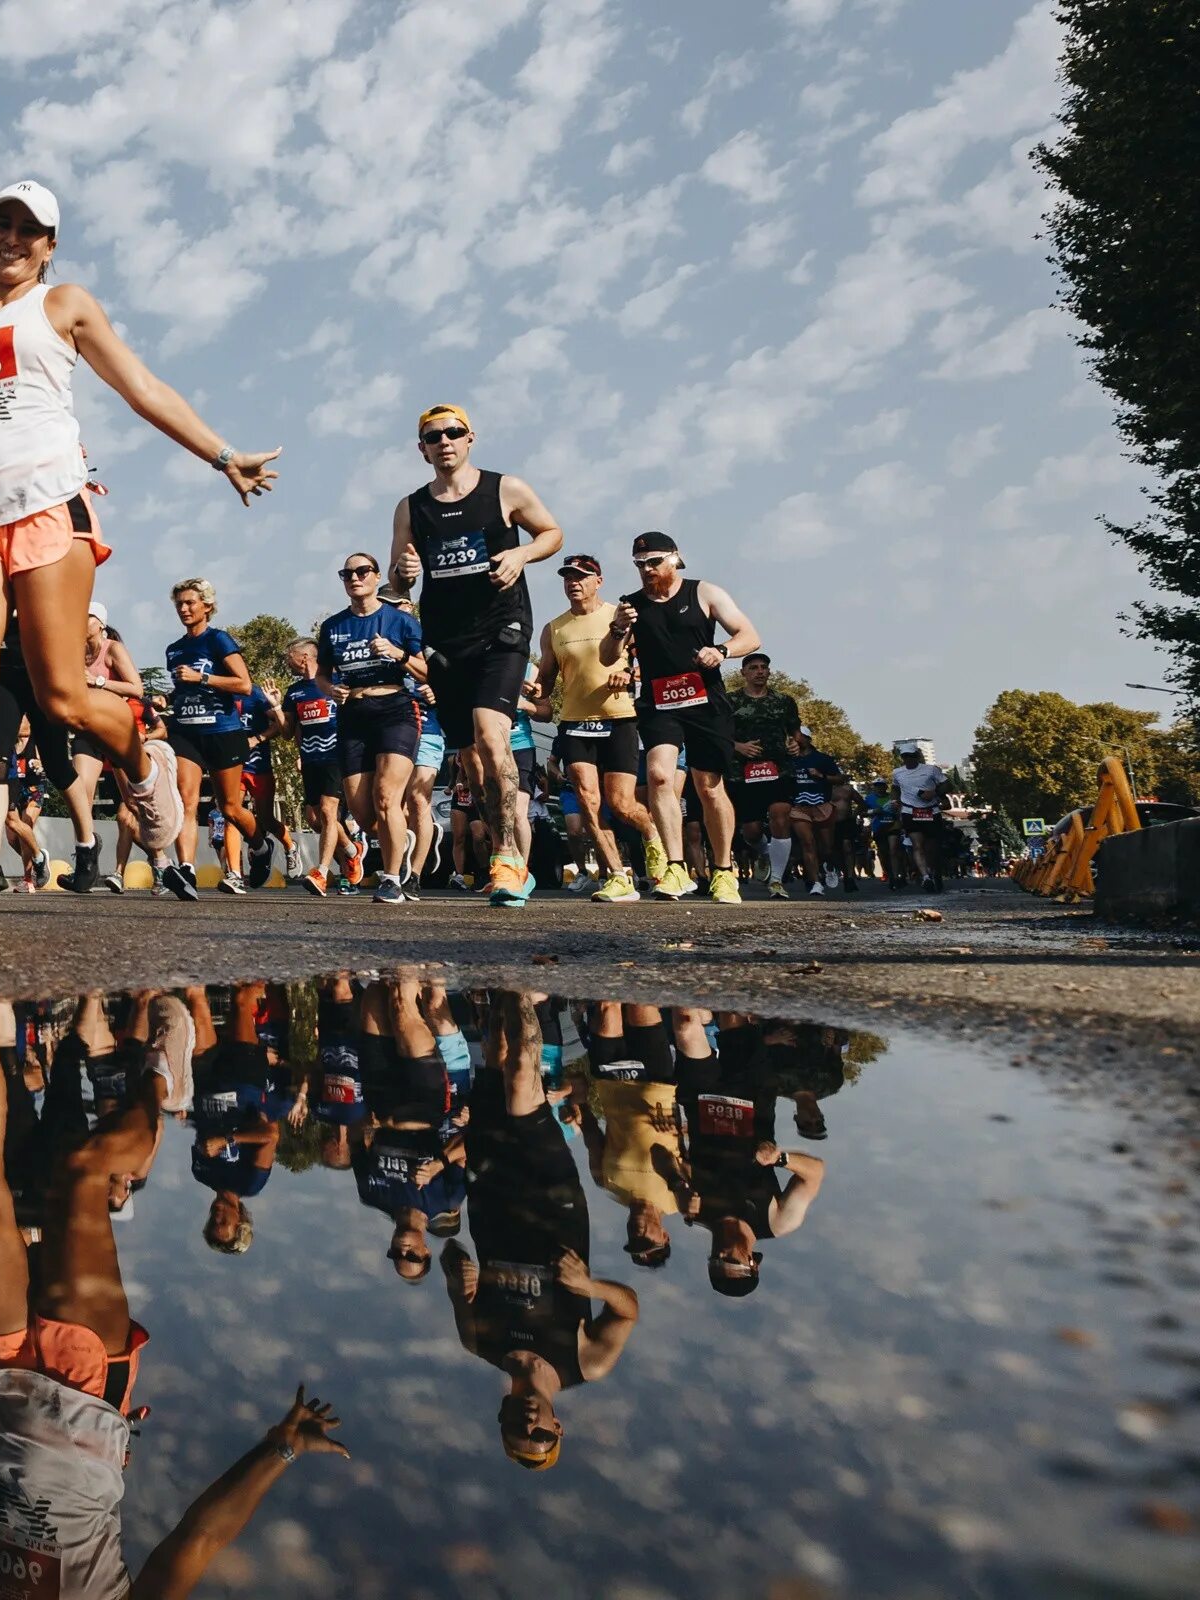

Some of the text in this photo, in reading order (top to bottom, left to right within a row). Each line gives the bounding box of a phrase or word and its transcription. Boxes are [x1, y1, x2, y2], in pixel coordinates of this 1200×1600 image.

[437, 548, 477, 566] 2239
[342, 648, 371, 661] 2145
[662, 686, 696, 701] 5038
[181, 705, 206, 715] 2015
[303, 709, 321, 719] 5107
[577, 721, 604, 730] 2196
[749, 768, 772, 777] 5046
